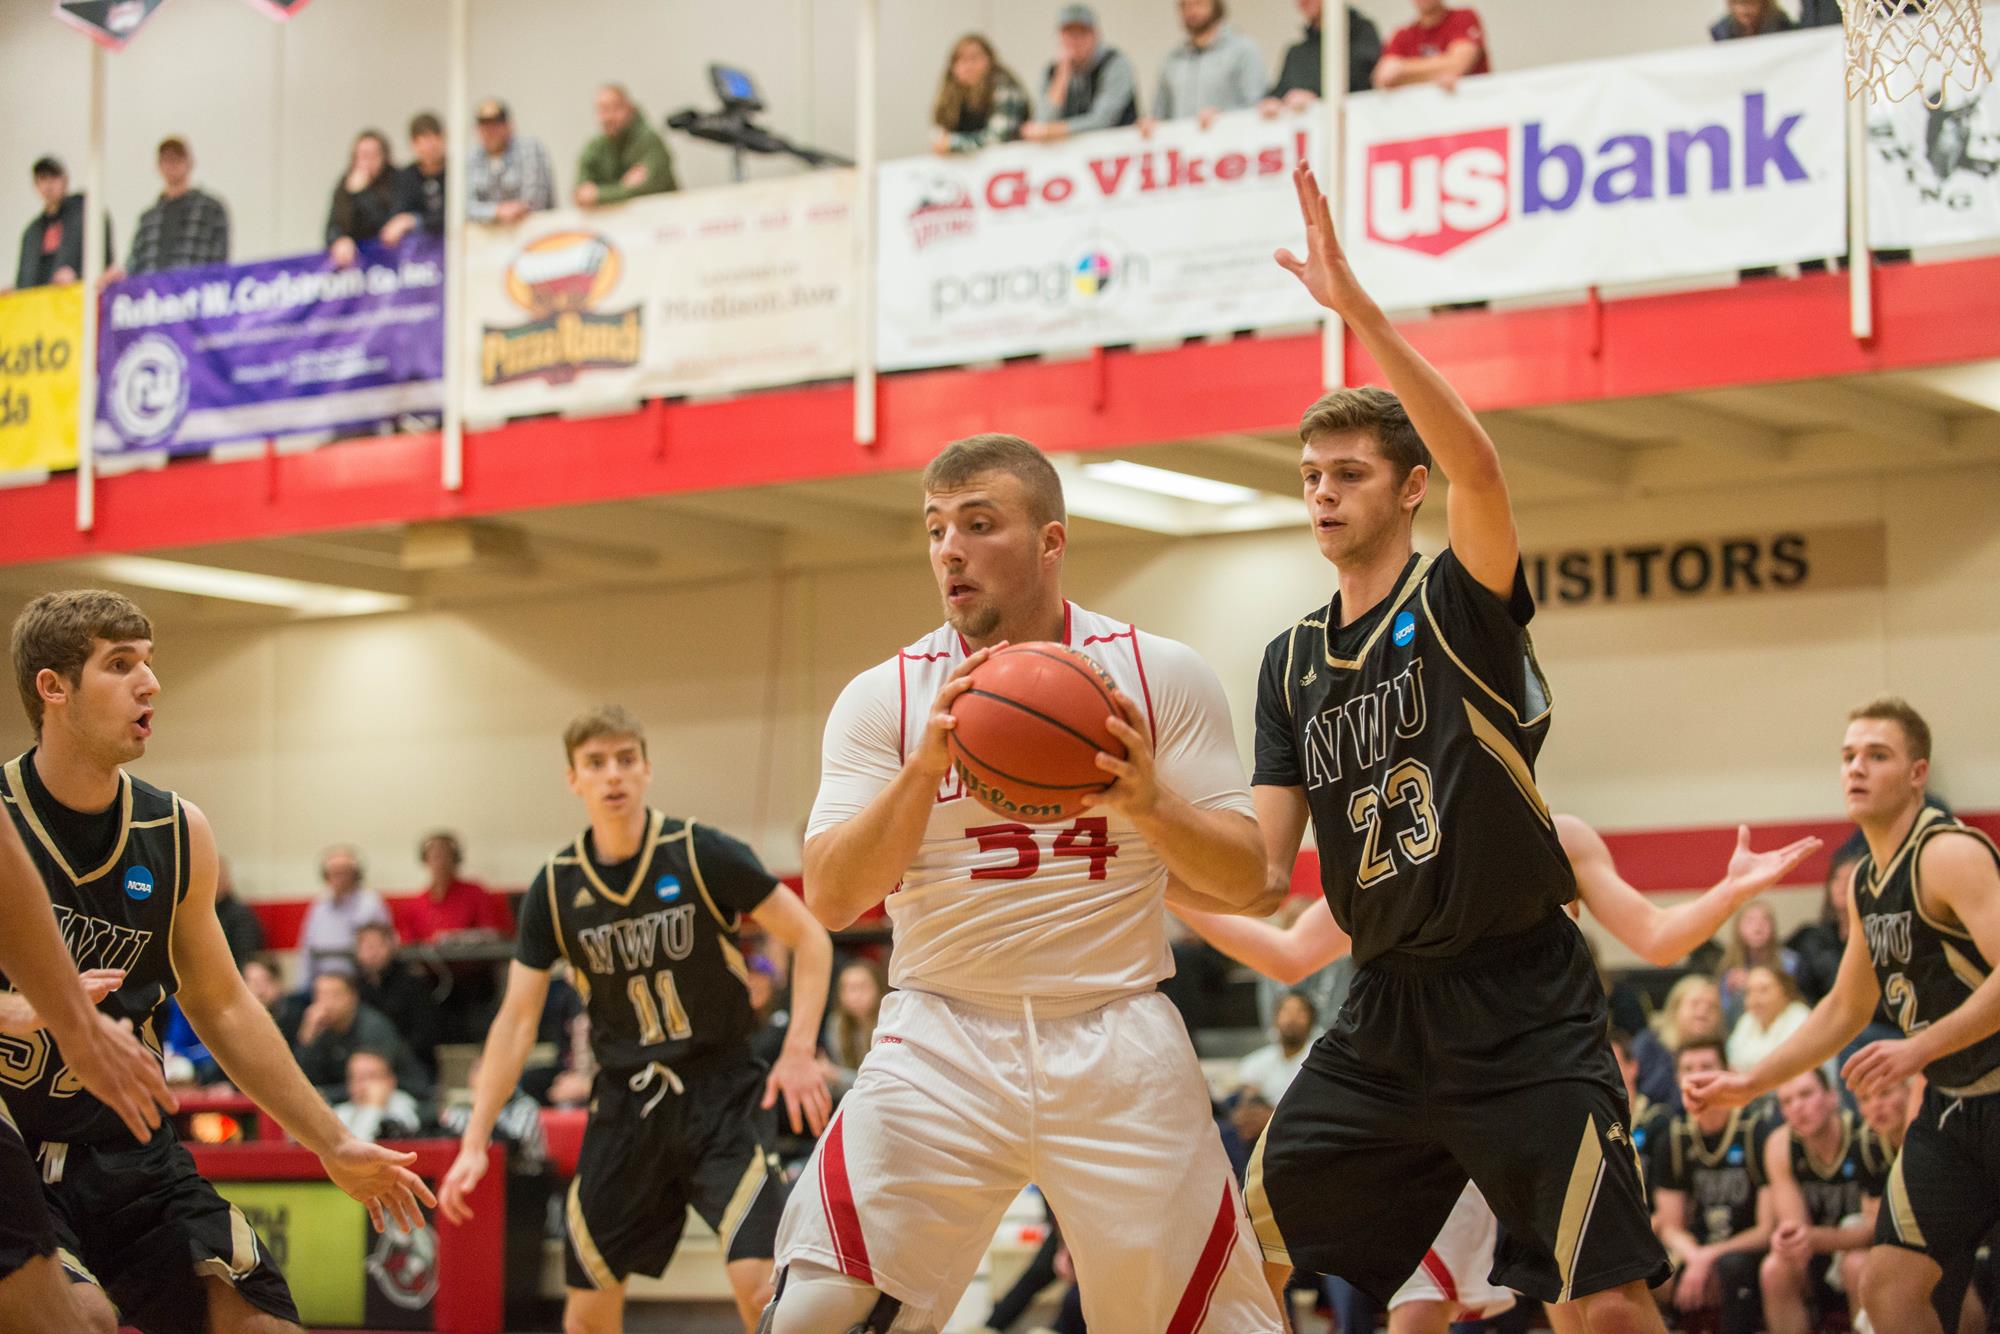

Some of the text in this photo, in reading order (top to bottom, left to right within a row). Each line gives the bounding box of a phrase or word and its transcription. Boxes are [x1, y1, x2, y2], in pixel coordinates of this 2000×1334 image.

[985, 130, 1307, 210] Go Vikes!
[1370, 92, 1811, 241] us bank
[1535, 532, 1810, 605] ISITORS
[1304, 656, 1428, 791] NWU
[964, 815, 1120, 881] 34
[1346, 756, 1442, 890] 23
[127, 880, 151, 894] NCAA
[52, 903, 153, 979] WU
[577, 902, 697, 975] NWU
[626, 968, 693, 1047] 11
[1885, 972, 1931, 1037] 2
